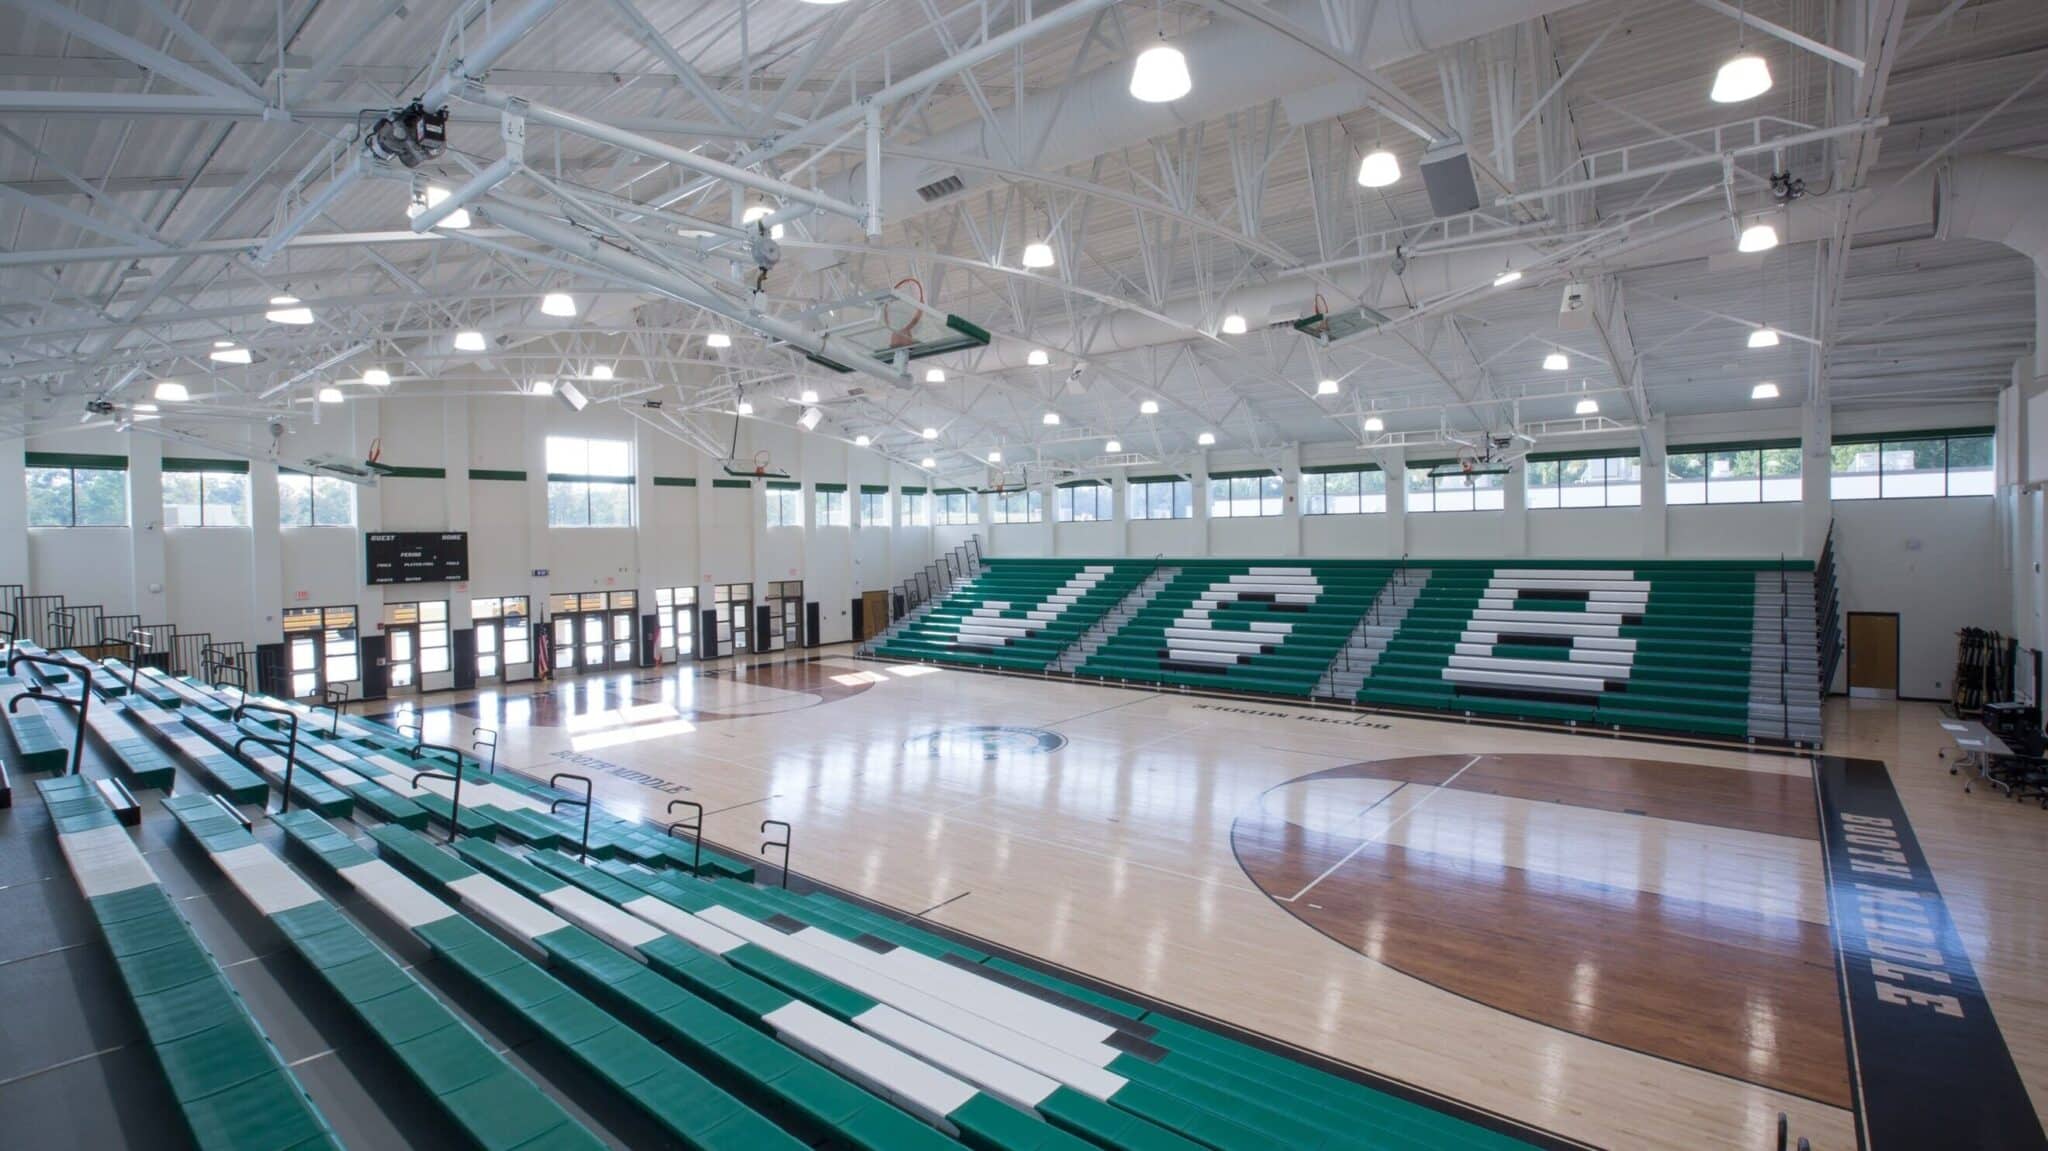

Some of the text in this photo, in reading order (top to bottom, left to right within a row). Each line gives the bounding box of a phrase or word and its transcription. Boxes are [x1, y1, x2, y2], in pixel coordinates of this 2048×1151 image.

[1442, 569, 1651, 691] B
[1840, 812, 1965, 1018] BOOTH MIDDLE
